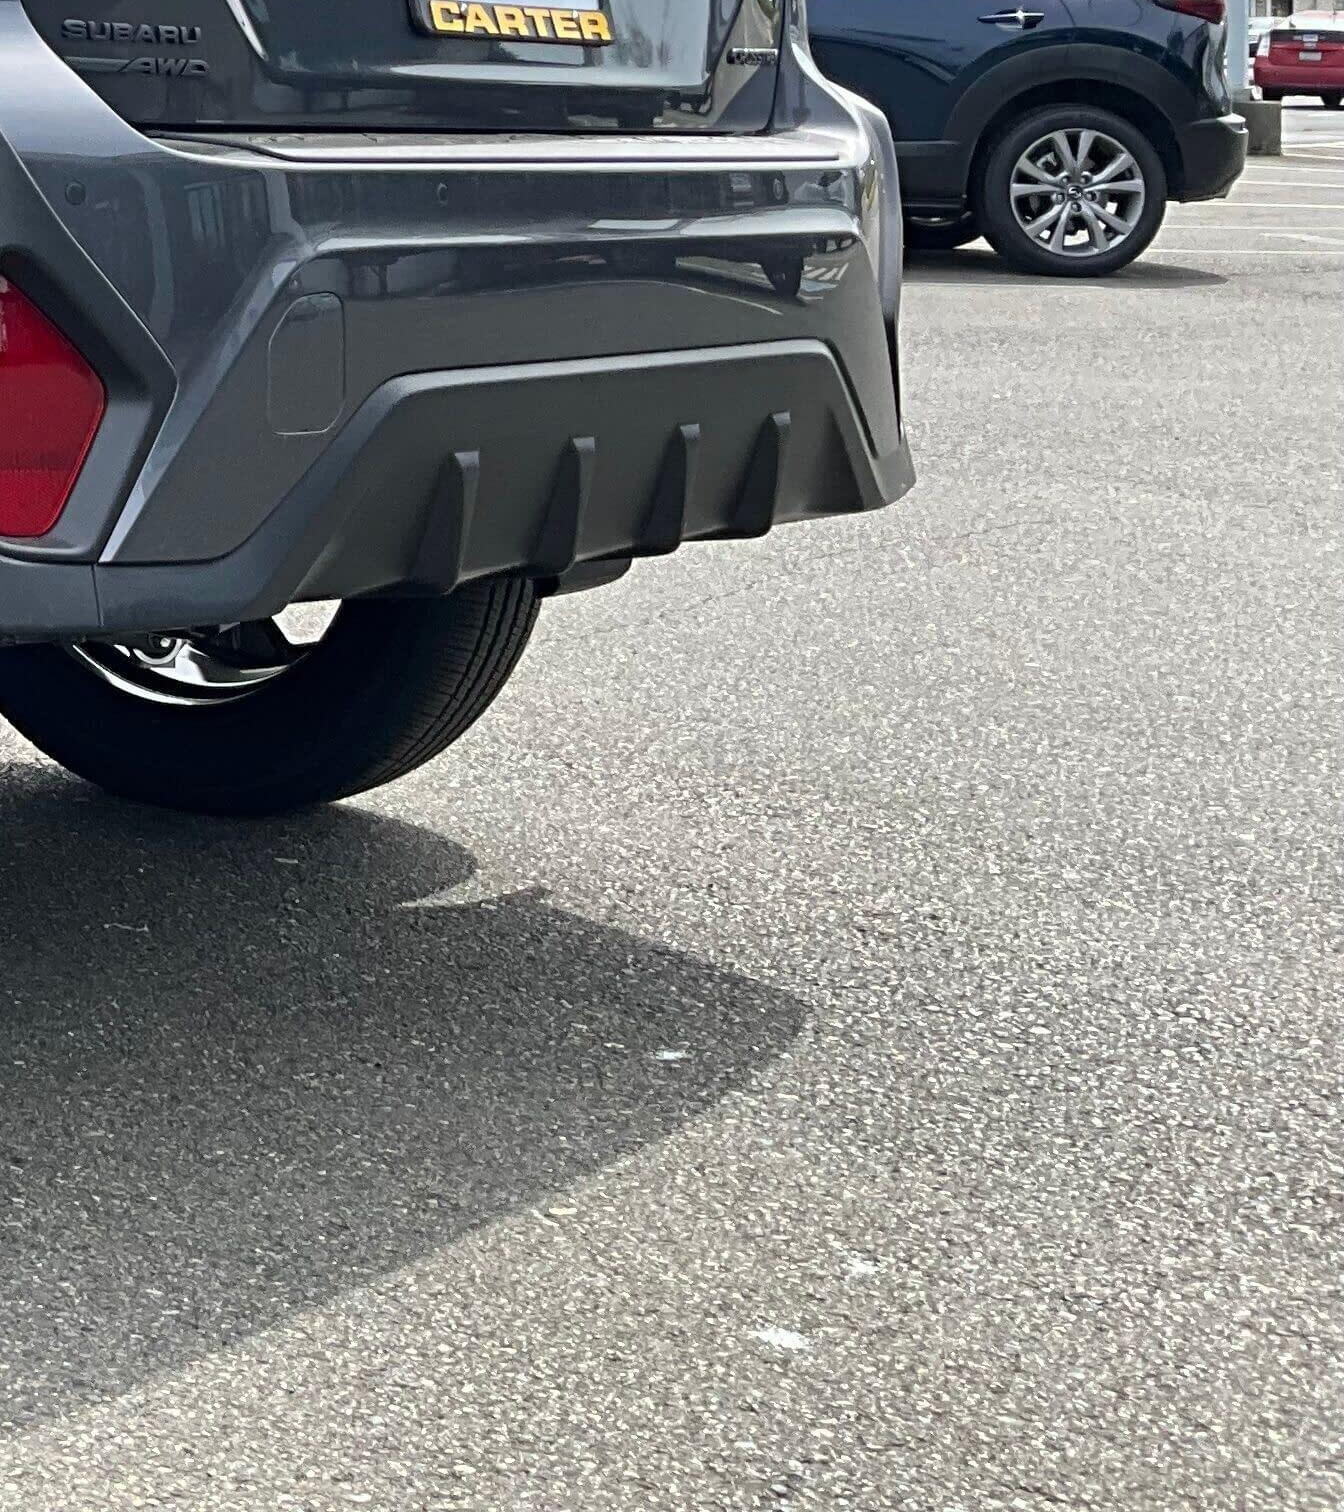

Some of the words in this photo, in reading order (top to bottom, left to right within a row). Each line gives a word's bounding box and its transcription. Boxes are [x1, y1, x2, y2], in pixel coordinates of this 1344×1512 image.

[62, 18, 202, 45] SUBARU
[429, 0, 613, 42] CARTER
[118, 55, 210, 78] AWD
